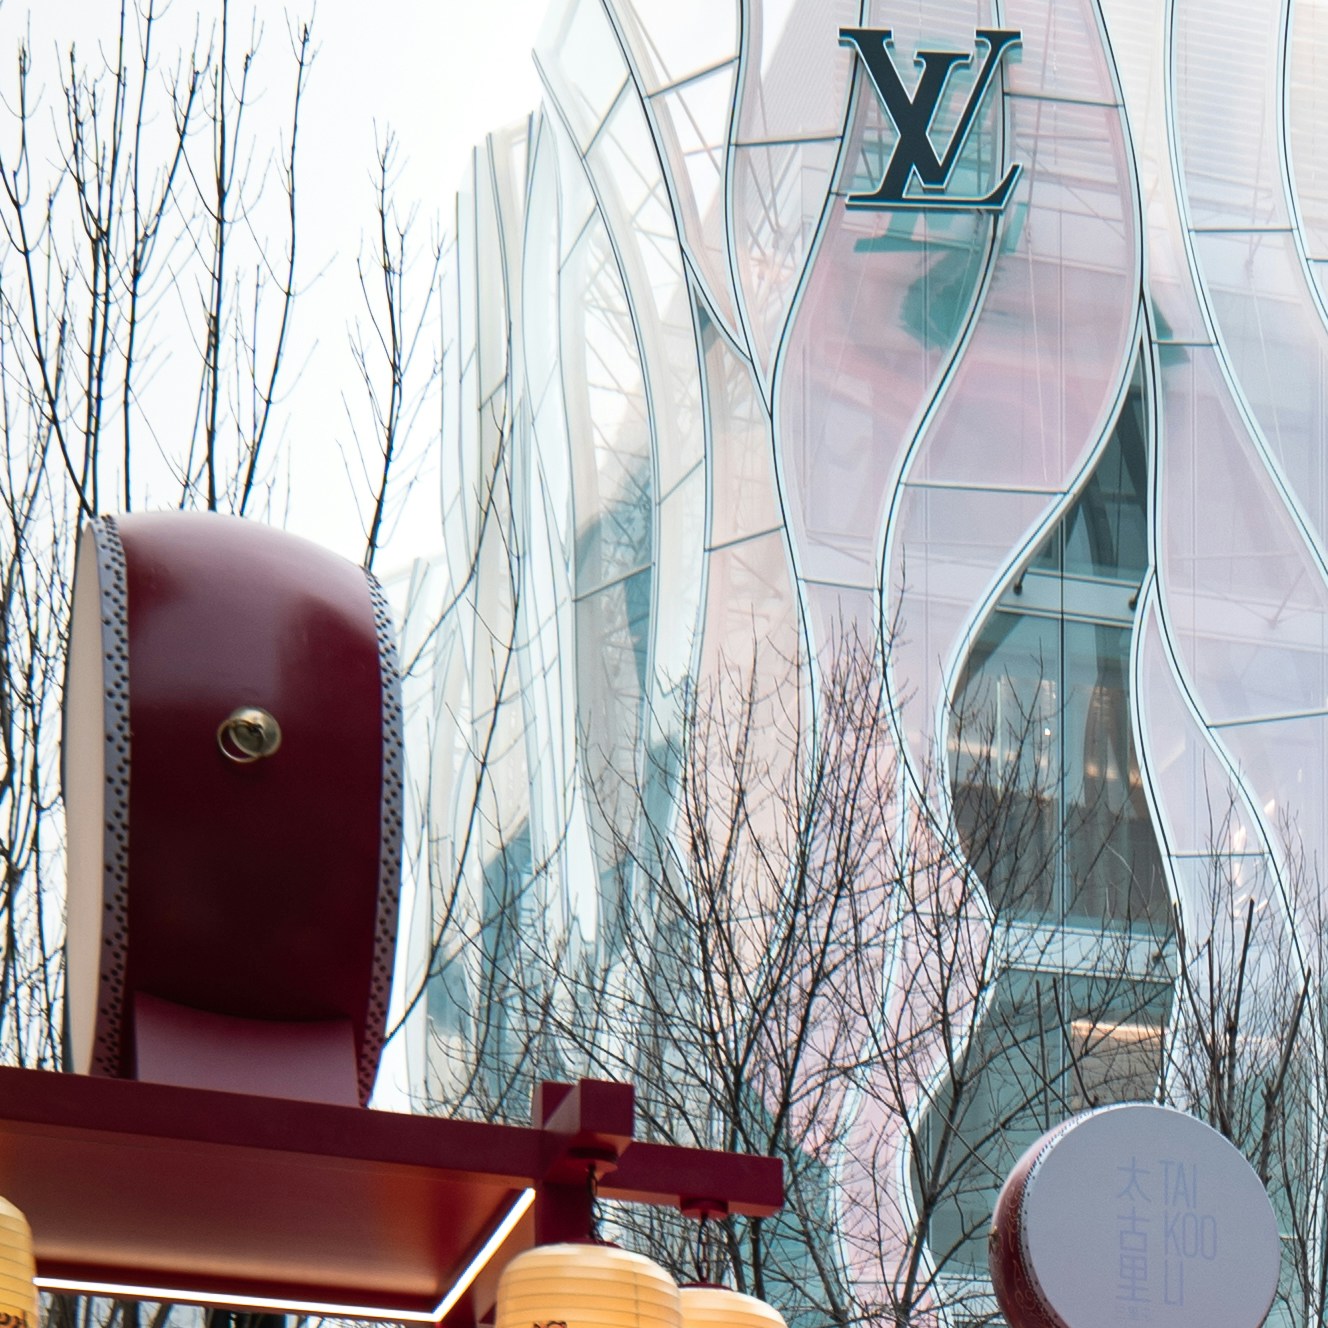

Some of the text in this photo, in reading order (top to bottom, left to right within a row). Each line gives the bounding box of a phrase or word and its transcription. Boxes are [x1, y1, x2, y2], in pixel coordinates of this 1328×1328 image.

[838, 27, 1023, 210] LV
[1116, 1156, 1151, 1302] 太古里
[1158, 1160, 1197, 1208] TAI
[1164, 1210, 1217, 1260] KOO
